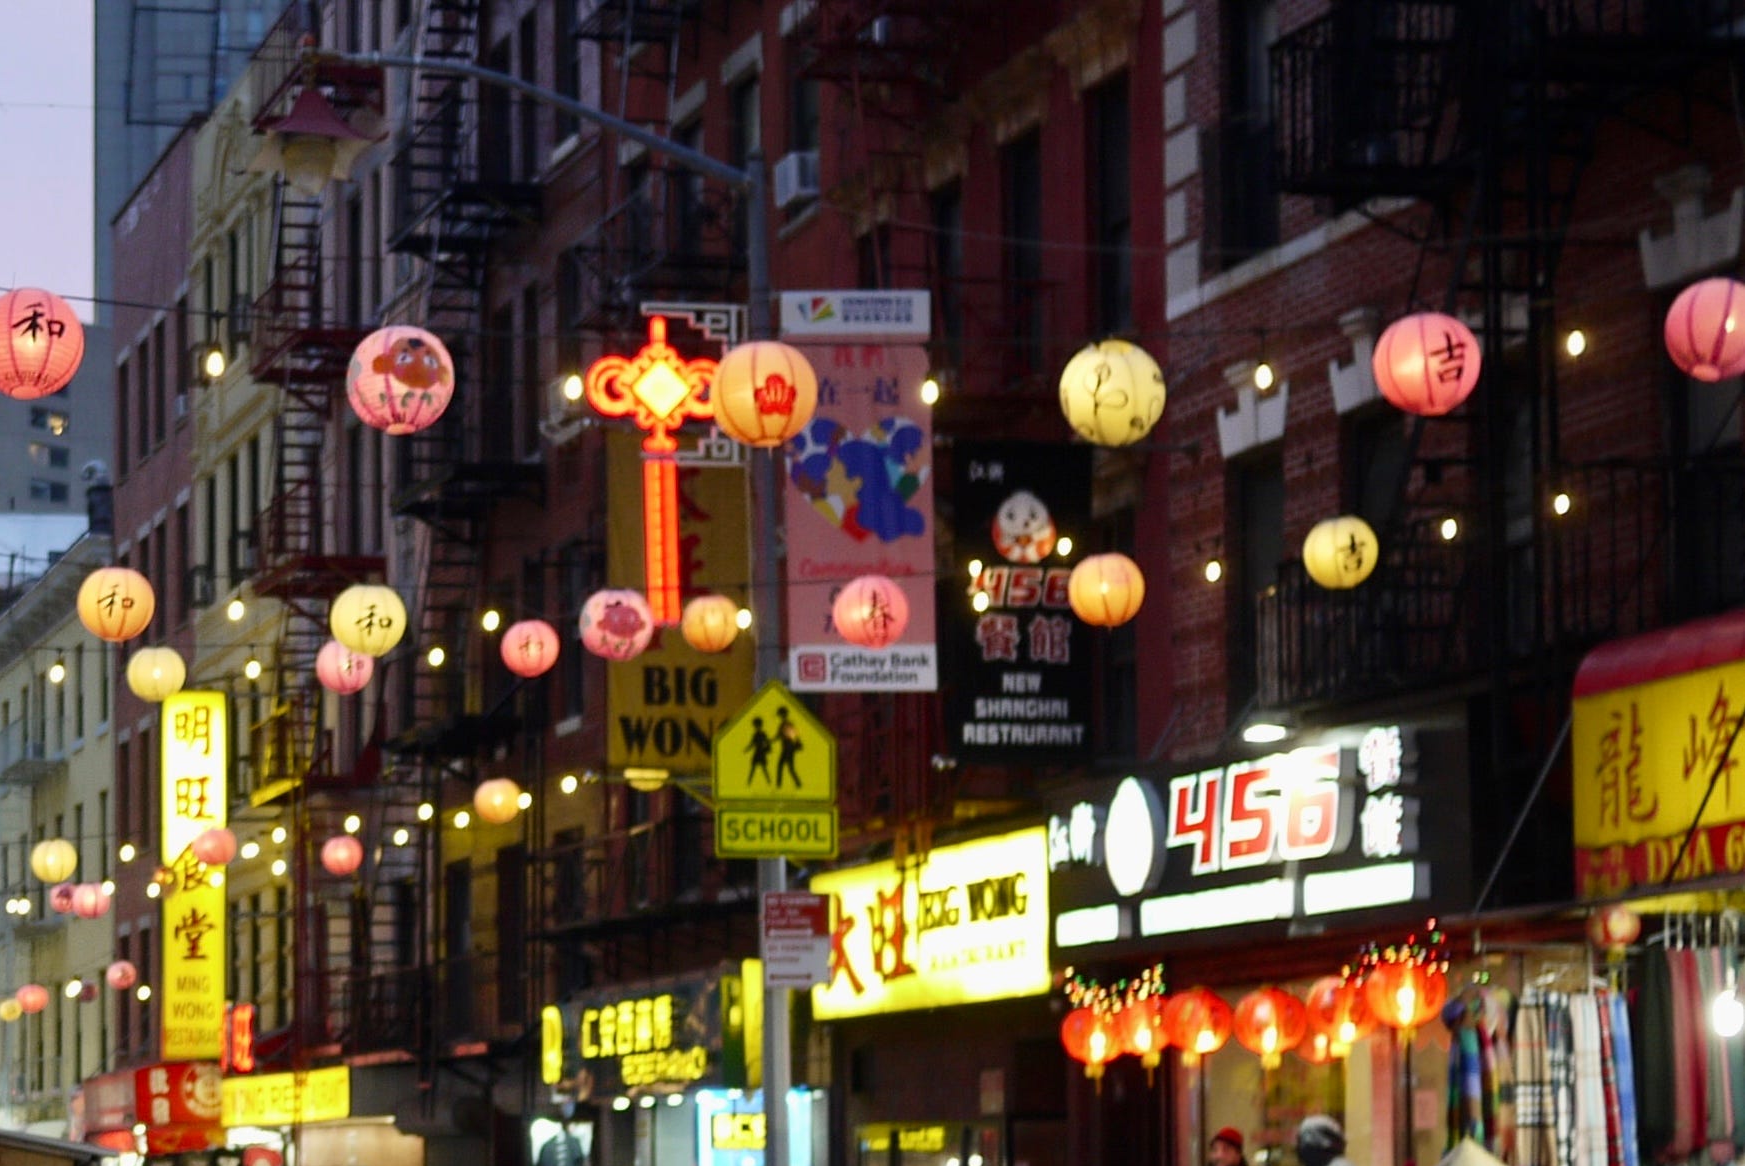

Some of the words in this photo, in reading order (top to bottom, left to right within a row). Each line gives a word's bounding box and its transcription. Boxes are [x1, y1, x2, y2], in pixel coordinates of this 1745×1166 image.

[12, 303, 66, 343] 和
[1429, 331, 1467, 384] 吉
[97, 584, 135, 618] 和
[356, 604, 393, 637] 和
[830, 652, 886, 669] Cathay
[892, 653, 929, 667] Bank
[643, 666, 719, 707] BIG
[831, 671, 918, 683] Foundation
[1002, 673, 1041, 692] NEW
[975, 699, 1069, 719] SHANGHAI
[619, 716, 714, 758] WON
[963, 724, 1084, 745] RESTAURANT
[1166, 743, 1342, 872] 456
[726, 818, 828, 844] SCHOOL
[966, 872, 1027, 922] WONG
[176, 975, 211, 994] MING
[172, 1003, 215, 1022] WONG
